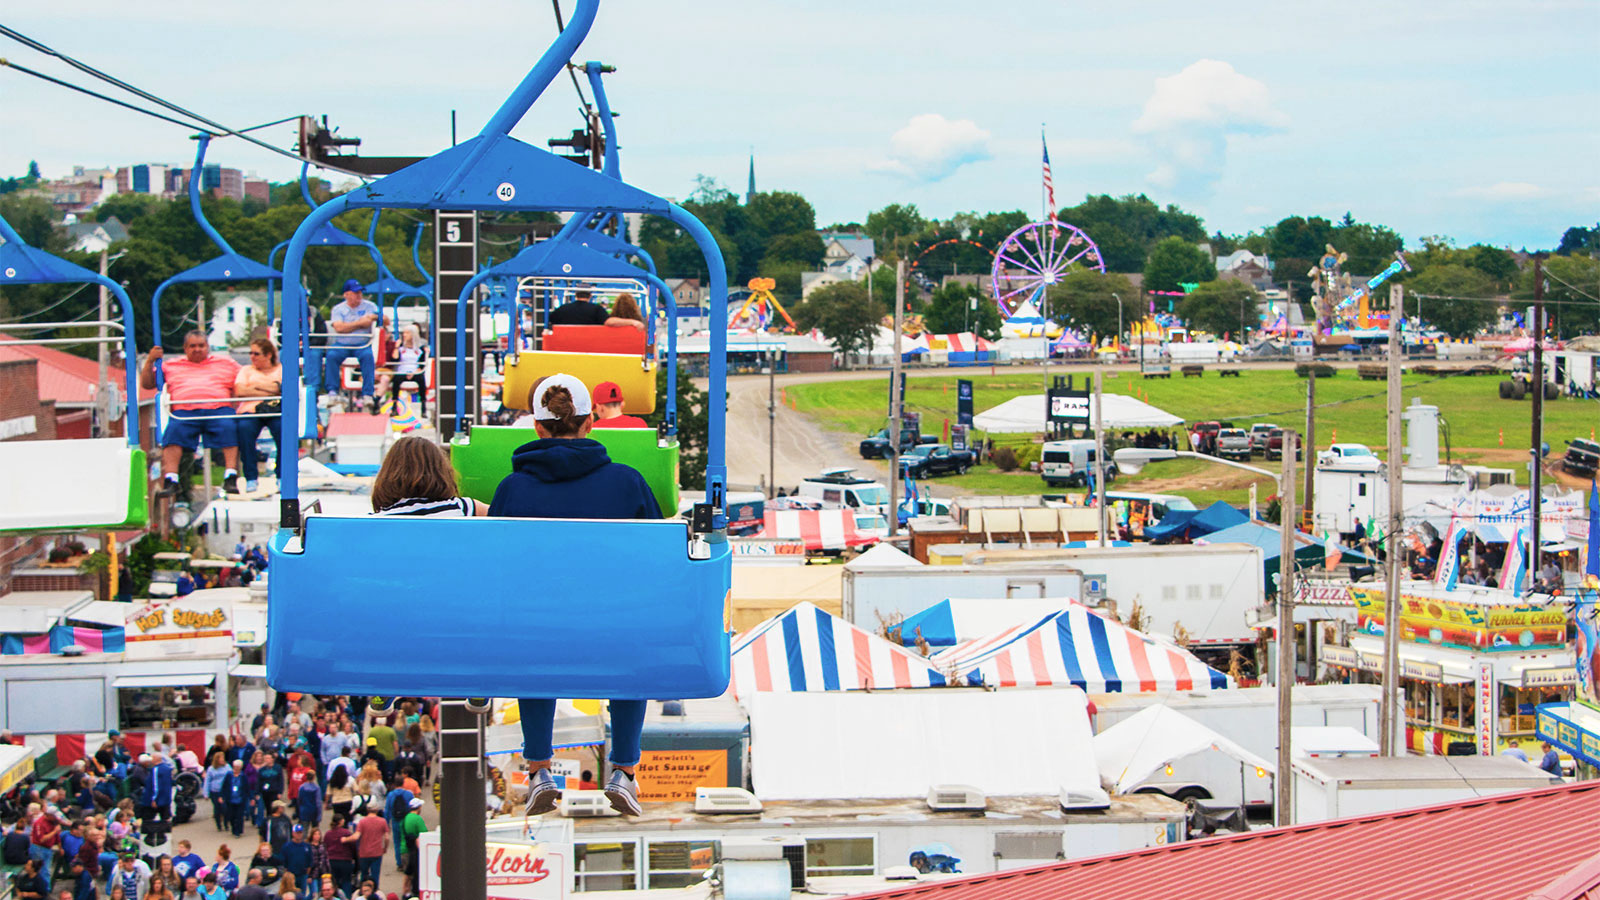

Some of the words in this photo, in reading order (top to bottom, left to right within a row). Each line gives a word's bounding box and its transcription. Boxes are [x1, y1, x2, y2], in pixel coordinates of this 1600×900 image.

[500, 187, 512, 197] 40
[446, 220, 461, 242] 5
[1300, 587, 1353, 600] PIZZA
[135, 609, 166, 633] HOT
[172, 607, 227, 629] SAUSAGE
[1489, 614, 1526, 626] FUNNEL
[1481, 666, 1490, 713] FUNNEL
[1481, 719, 1490, 757] CAKES
[639, 763, 659, 771] Hot
[663, 763, 711, 772] Sausage
